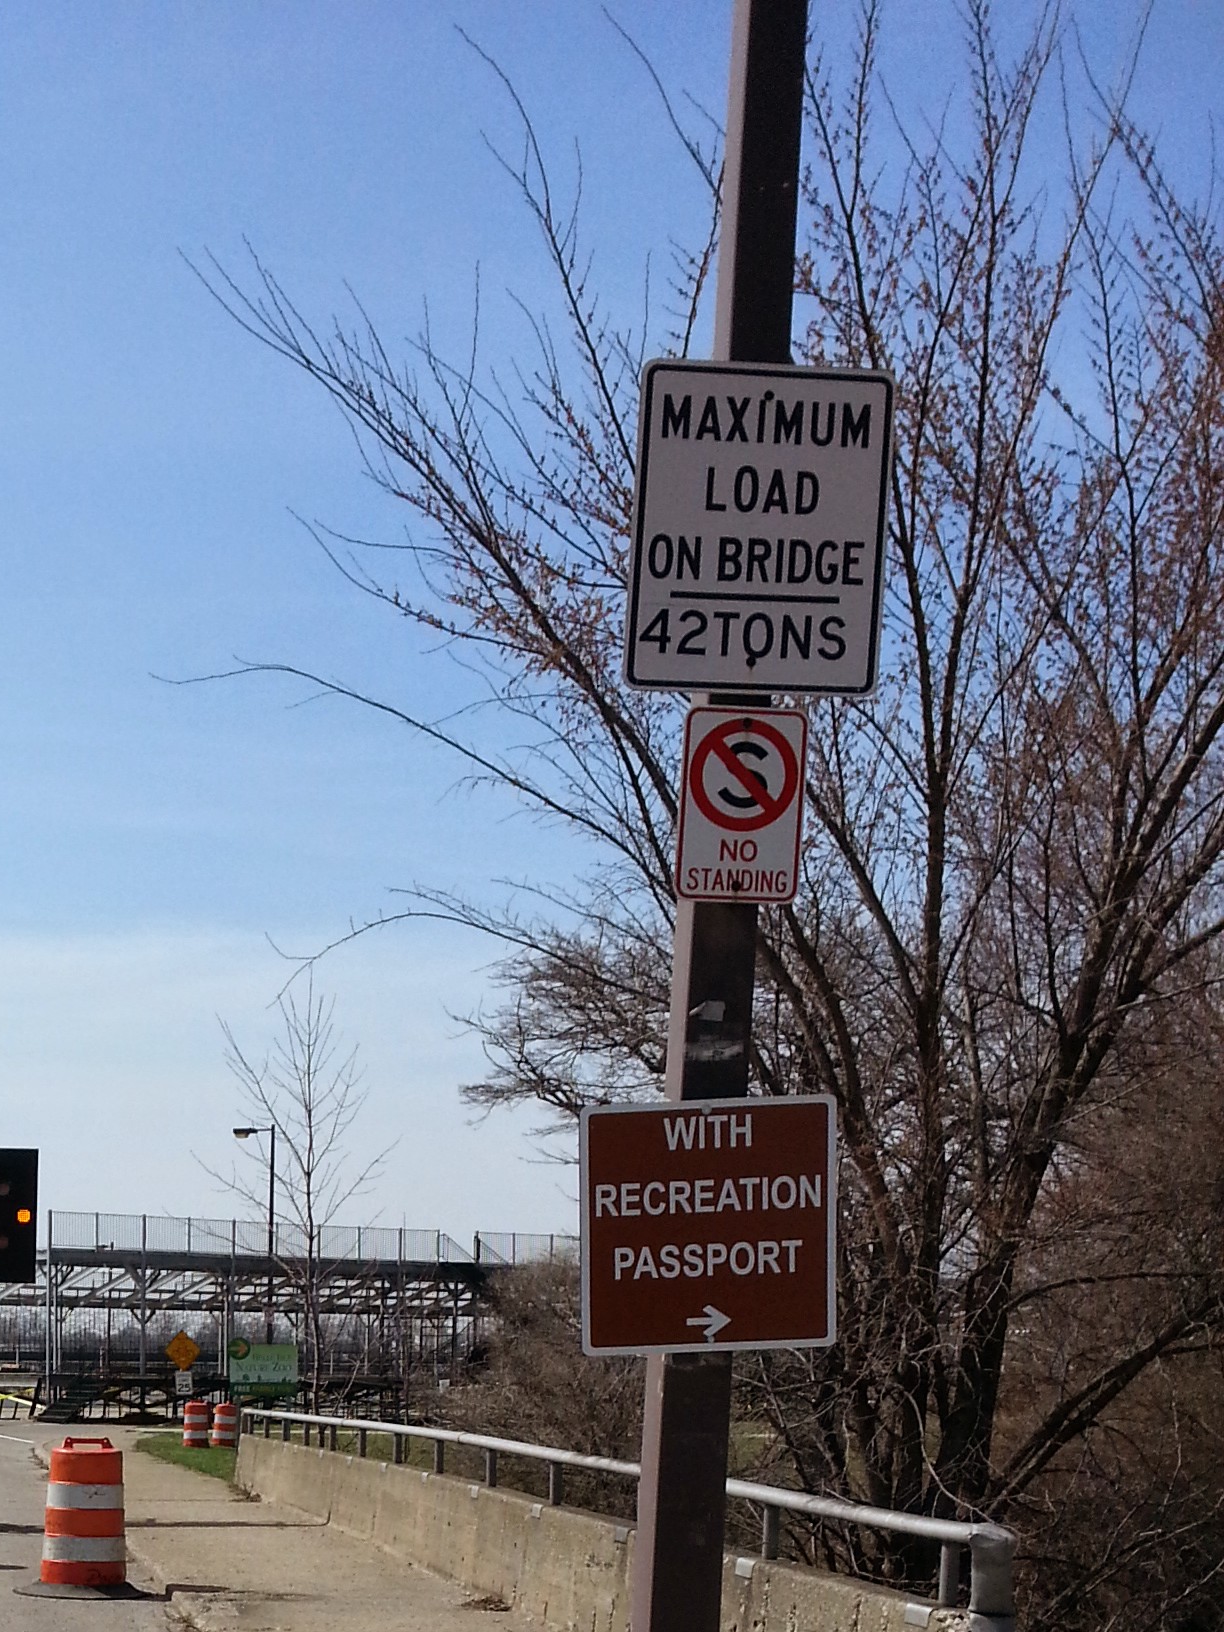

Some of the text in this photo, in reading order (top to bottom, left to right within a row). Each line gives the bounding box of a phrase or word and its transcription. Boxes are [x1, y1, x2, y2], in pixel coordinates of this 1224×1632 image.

[662, 393, 871, 448] MAXIMUM
[706, 466, 819, 515] LOAD
[648, 534, 865, 586] ON BRIDGE
[719, 838, 758, 862] NO
[686, 867, 788, 893] STANDING
[664, 1114, 752, 1151] WITH
[595, 1174, 822, 1218] RECREATION
[614, 1239, 803, 1281] PASSPORT
[178, 1383, 191, 1392] 25
